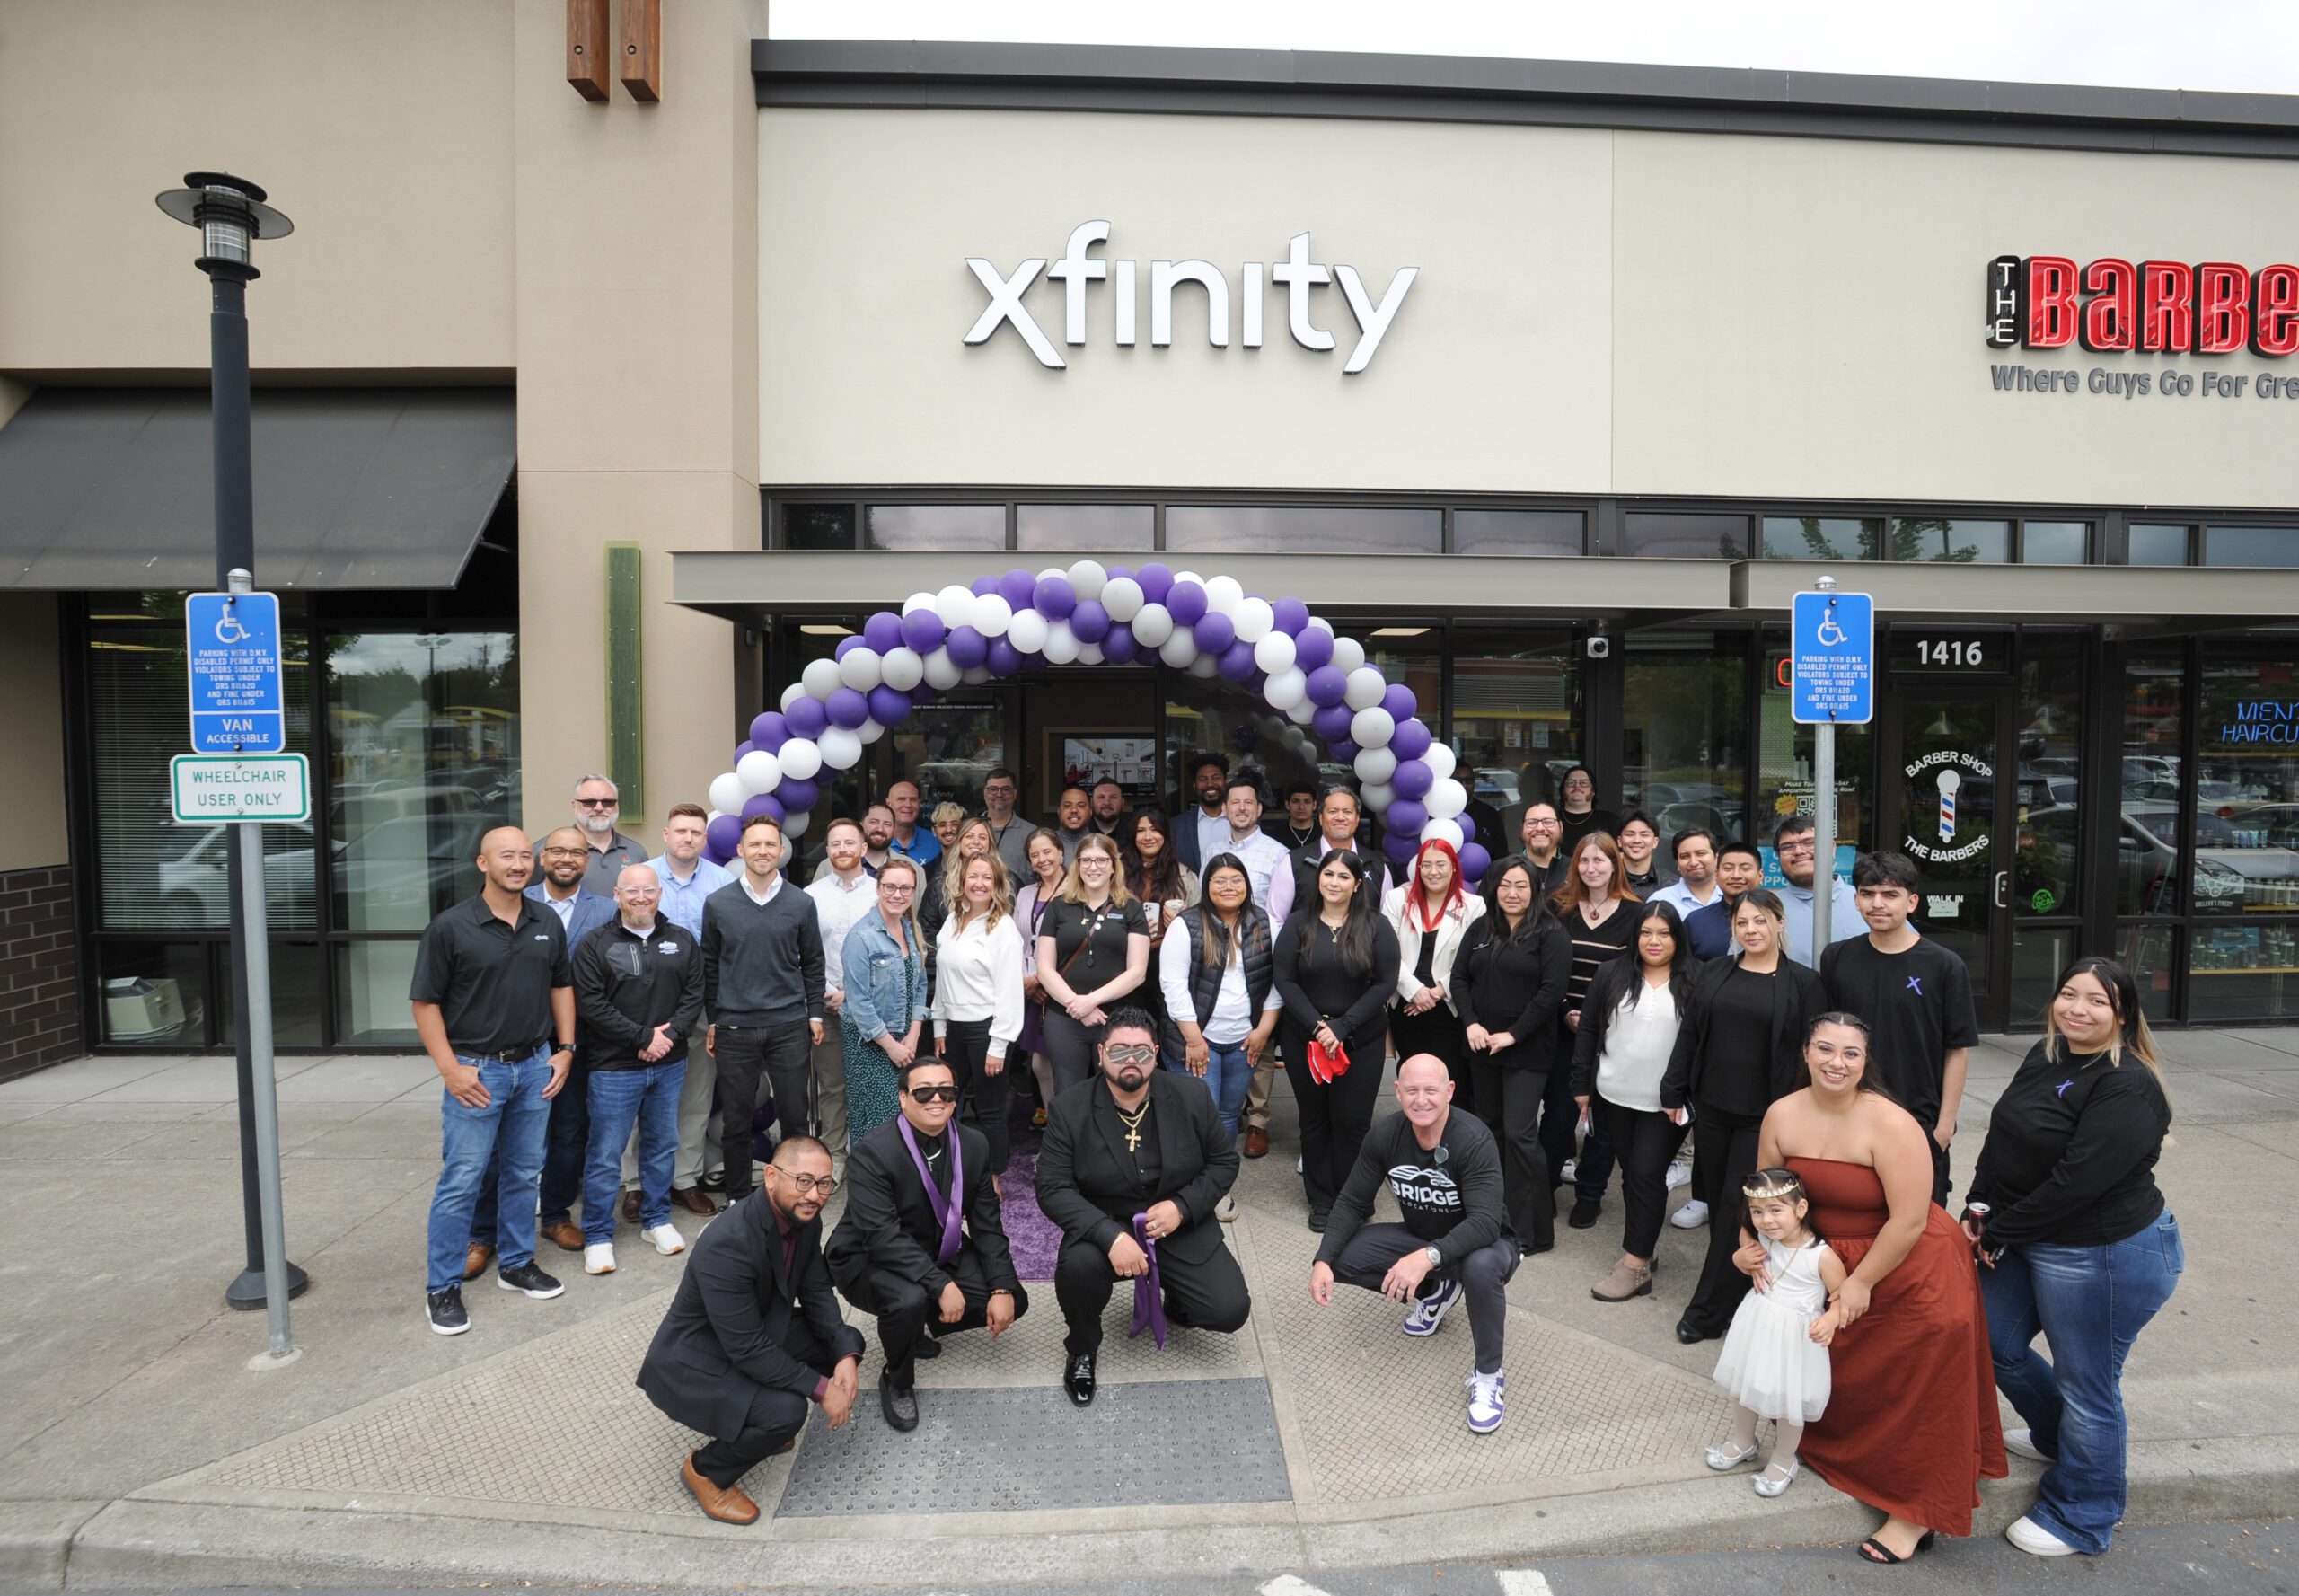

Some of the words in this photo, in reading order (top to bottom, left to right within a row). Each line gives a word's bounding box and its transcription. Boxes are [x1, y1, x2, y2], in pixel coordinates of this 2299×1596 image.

[962, 219, 1421, 375] xfinity
[1995, 262, 2016, 344] THE
[1991, 364, 2080, 392] Where
[2088, 367, 2152, 399] Guys
[2160, 369, 2194, 397] Go
[2203, 371, 2249, 397] For
[1802, 655, 1828, 663] PARKING
[1917, 640, 1983, 666] 1416
[194, 657, 227, 666] DISABLED
[195, 666, 232, 674] VIOLATORS
[222, 718, 253, 732] VAN
[207, 733, 269, 744] ACCESSIBLE
[1905, 750, 1959, 778] BARBER
[1960, 753, 1993, 778] SHOP
[192, 771, 286, 784] WHEELCHAIR
[198, 794, 236, 807] USER
[244, 793, 282, 806] ONLY
[1904, 835, 1930, 859] THE
[1930, 834, 1990, 863] BARBERS
[1926, 895, 1952, 904] WALK
[1391, 1178, 1461, 1205] BRIDGE
